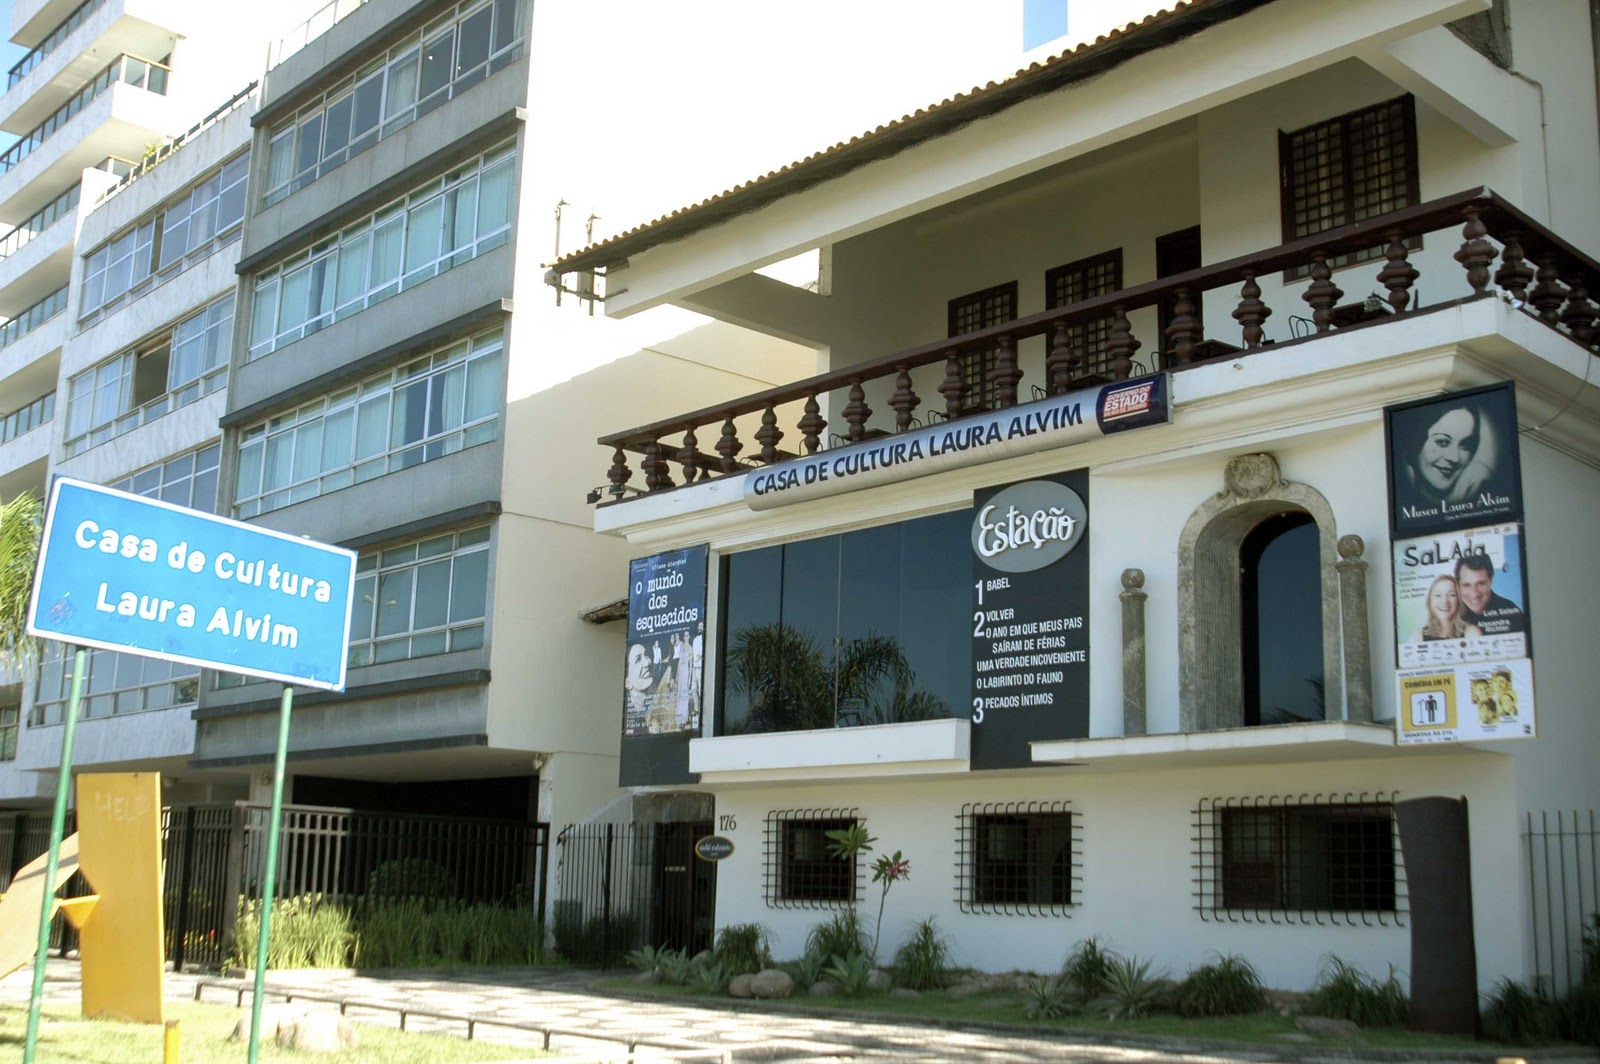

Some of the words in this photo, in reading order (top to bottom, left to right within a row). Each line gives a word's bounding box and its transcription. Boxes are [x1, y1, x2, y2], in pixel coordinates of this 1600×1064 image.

[1105, 392, 1148, 412] ESTADO
[1106, 389, 1139, 401] GOVERNO
[1140, 385, 1150, 393] DO
[753, 468, 800, 495] CASA
[805, 461, 829, 485] DE
[833, 439, 924, 478] CULTURA
[929, 422, 1003, 456] LAURA
[1008, 403, 1083, 440] ALVIM
[1402, 504, 1438, 519] Museu
[1441, 500, 1473, 513] Laura
[1477, 492, 1510, 507] Alvim
[978, 505, 1077, 557] Estação
[75, 520, 158, 562] Casa
[167, 541, 206, 573] de
[214, 551, 332, 603] Cultura
[647, 570, 683, 592] mundo
[975, 579, 983, 605] 1
[986, 577, 1011, 591] BABEL
[648, 593, 668, 610] dos
[96, 582, 196, 629] Laura
[205, 606, 299, 649] Alvim
[635, 606, 698, 632] esquecidos
[973, 611, 985, 637] 2
[986, 608, 1015, 622] VOLVER
[986, 628, 992, 638] O
[992, 627, 1008, 638] ANO
[1009, 625, 1021, 637] EM
[1022, 623, 1038, 635] QUE
[1039, 619, 1063, 633] MEUS
[1063, 616, 1083, 630] PAIS
[992, 639, 1023, 654] SAÍRAM
[1024, 639, 1034, 651] DE
[1037, 635, 1066, 650] FÉRIAS
[976, 659, 994, 672] UMA
[995, 655, 1030, 669] VERDADE
[1030, 650, 1086, 666] INCOVENIENTE
[976, 678, 982, 689] O
[983, 674, 1022, 688] LABIRINTO
[1024, 673, 1034, 685] DO
[1037, 671, 1064, 685] FAUNO
[973, 697, 984, 724] 3
[985, 695, 1019, 709] PECADOS
[1021, 692, 1053, 707] ÍNTIMOS
[719, 814, 737, 831] 176
